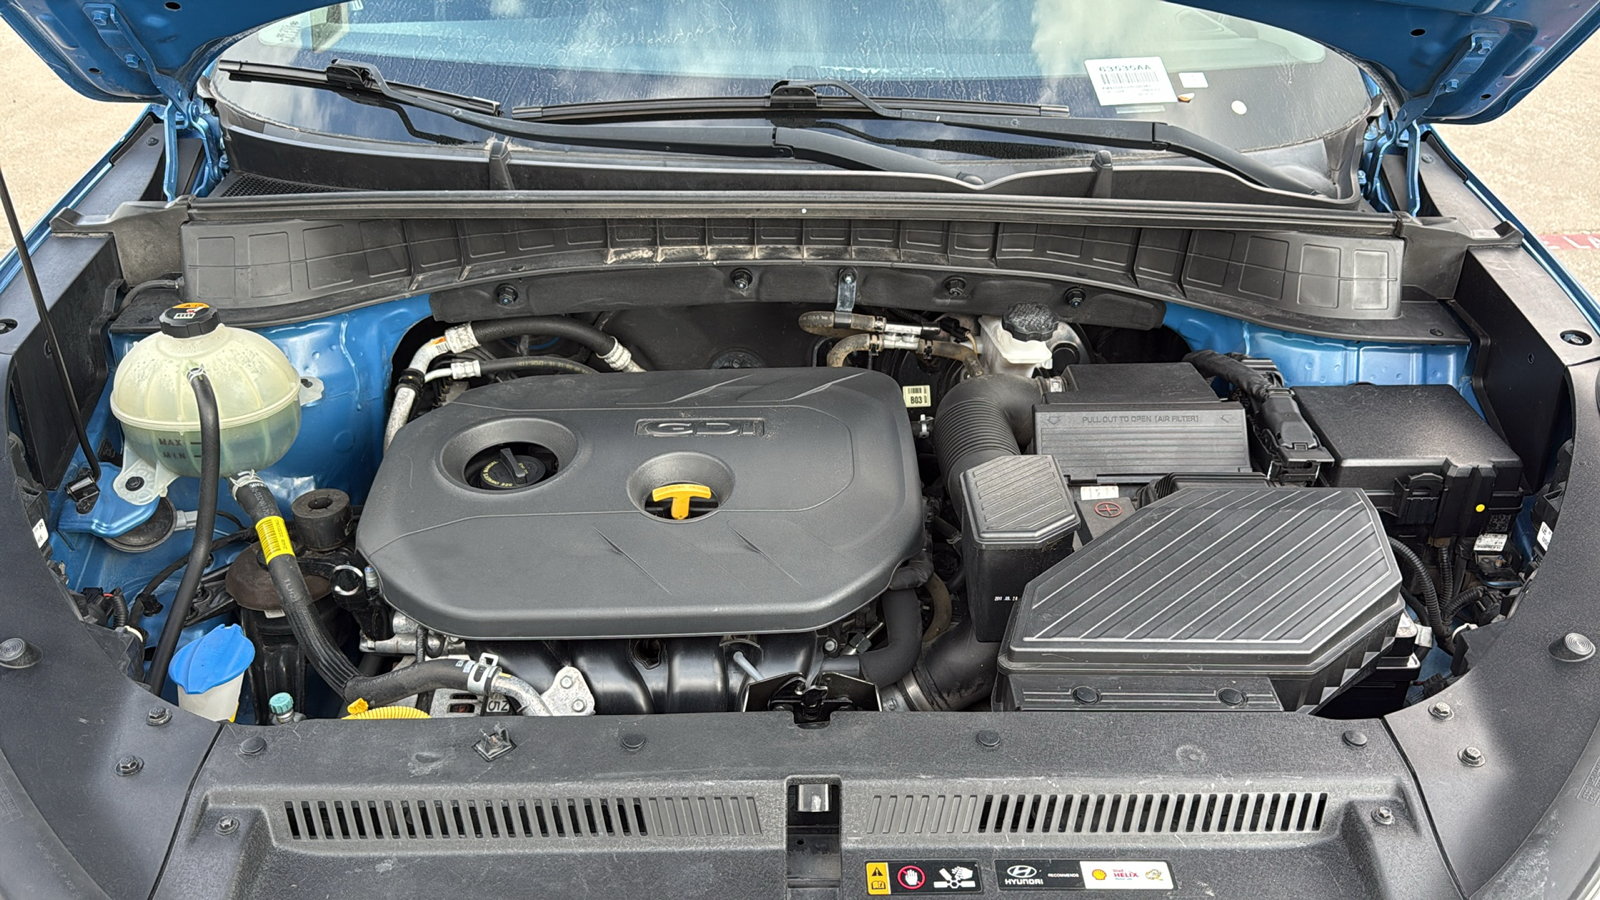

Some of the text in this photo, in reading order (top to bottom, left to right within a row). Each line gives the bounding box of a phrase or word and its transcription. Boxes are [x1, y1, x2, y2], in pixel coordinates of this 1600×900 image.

[910, 396, 923, 404] B03
[1131, 415, 1152, 423] OPEN
[644, 421, 755, 437] GDI
[158, 438, 182, 446] MAX
